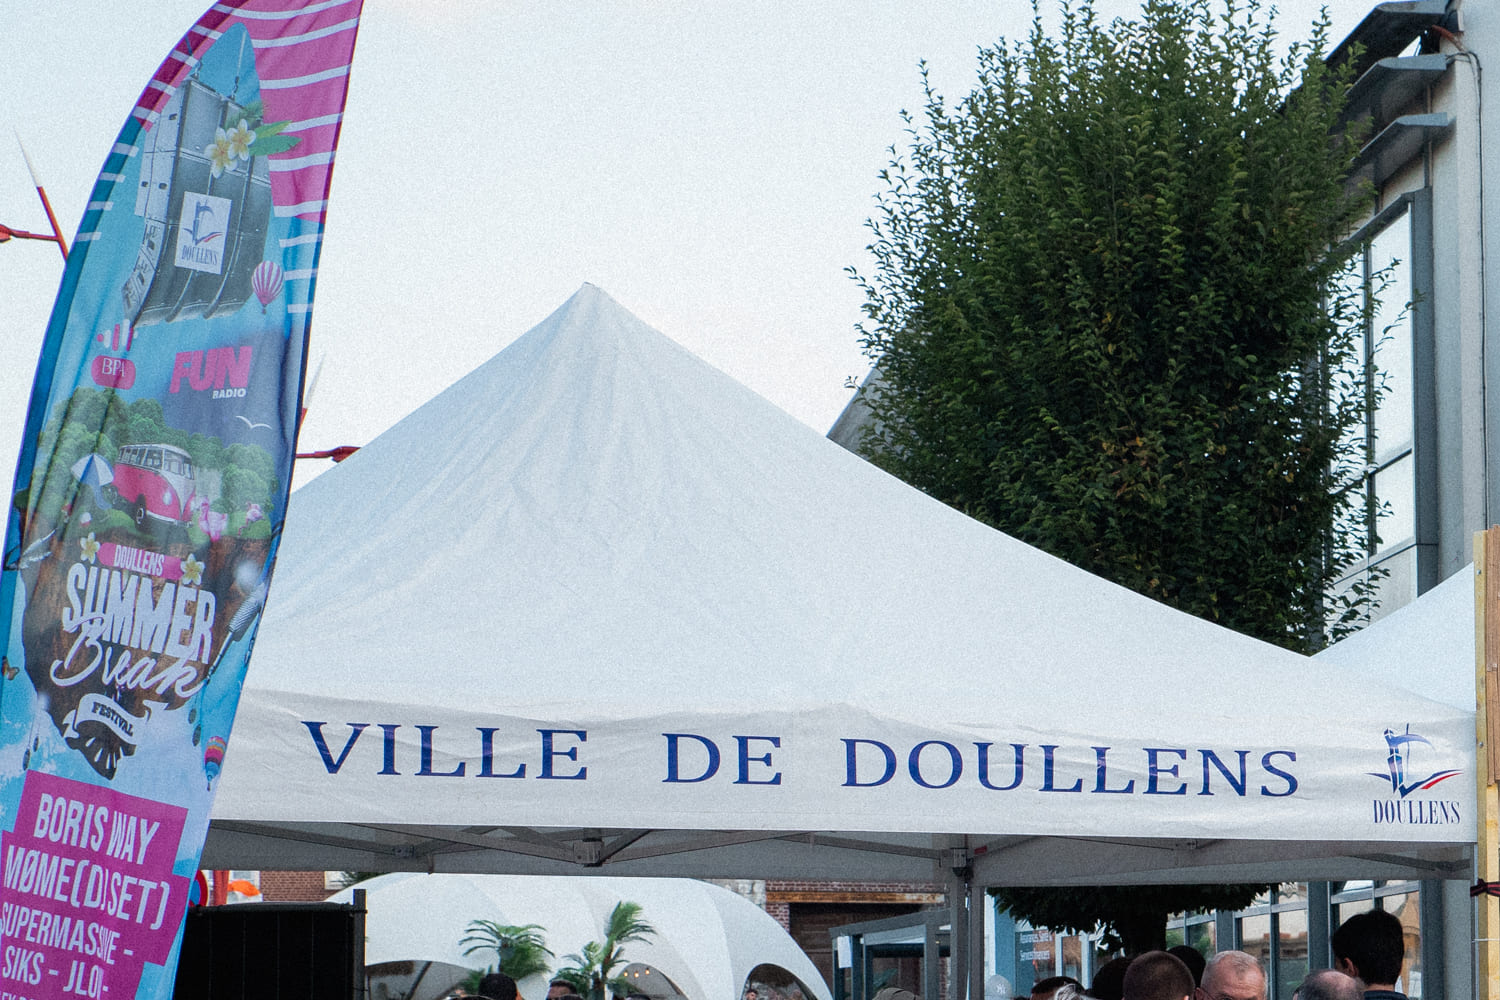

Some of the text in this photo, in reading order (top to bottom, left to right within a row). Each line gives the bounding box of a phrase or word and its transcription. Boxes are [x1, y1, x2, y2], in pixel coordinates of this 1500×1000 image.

[169, 346, 253, 394] FUN
[212, 388, 247, 399] RADIO
[113, 544, 165, 576] DOULLENS
[62, 563, 216, 664] SUMMER
[50, 616, 210, 698] Break
[91, 701, 134, 737] FESTIVAL
[301, 720, 1299, 797] VILLE DE DOULLENS
[33, 793, 161, 865] BORIS WAY
[1373, 799, 1461, 825] DOULLENS
[2, 945, 45, 985] SIKS
